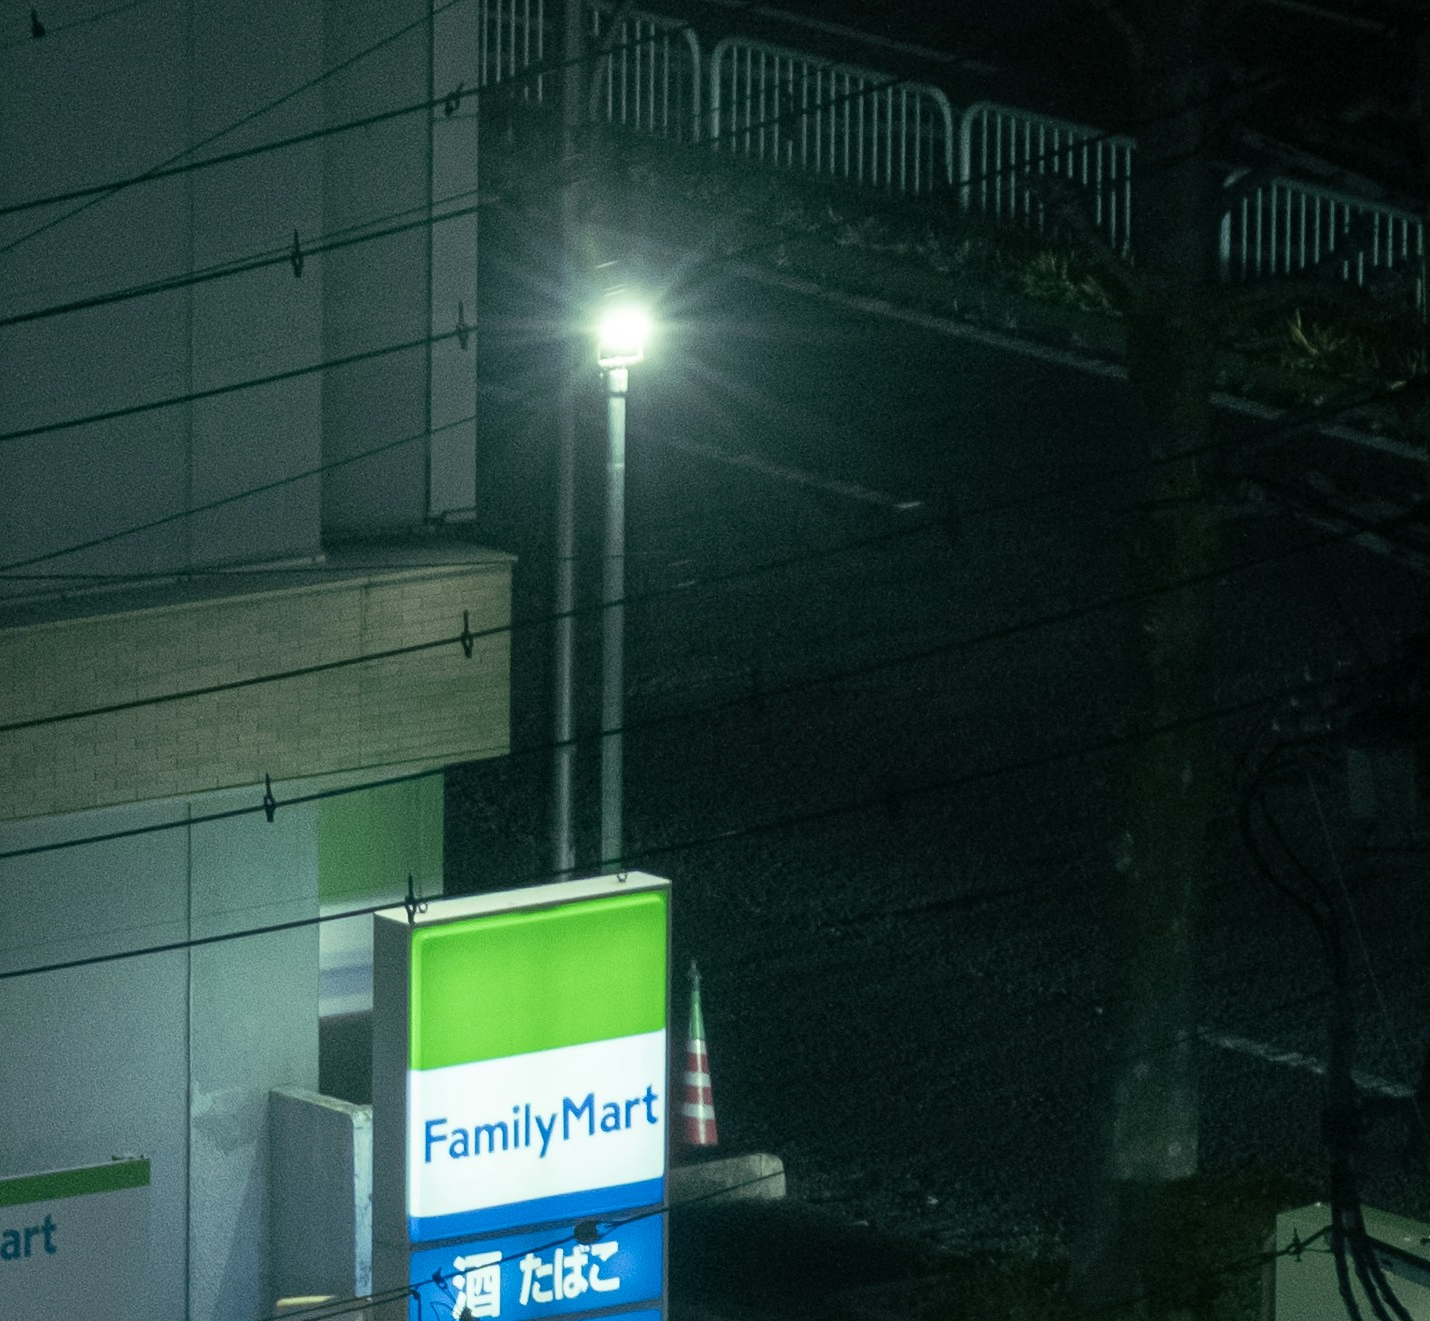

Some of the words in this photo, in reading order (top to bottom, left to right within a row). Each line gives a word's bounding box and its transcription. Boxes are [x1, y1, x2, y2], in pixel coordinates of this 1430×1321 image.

[423, 1084, 659, 1164] FamilyMart
[452, 1251, 503, 1319] 酒
[518, 1240, 622, 1306] たばこ
